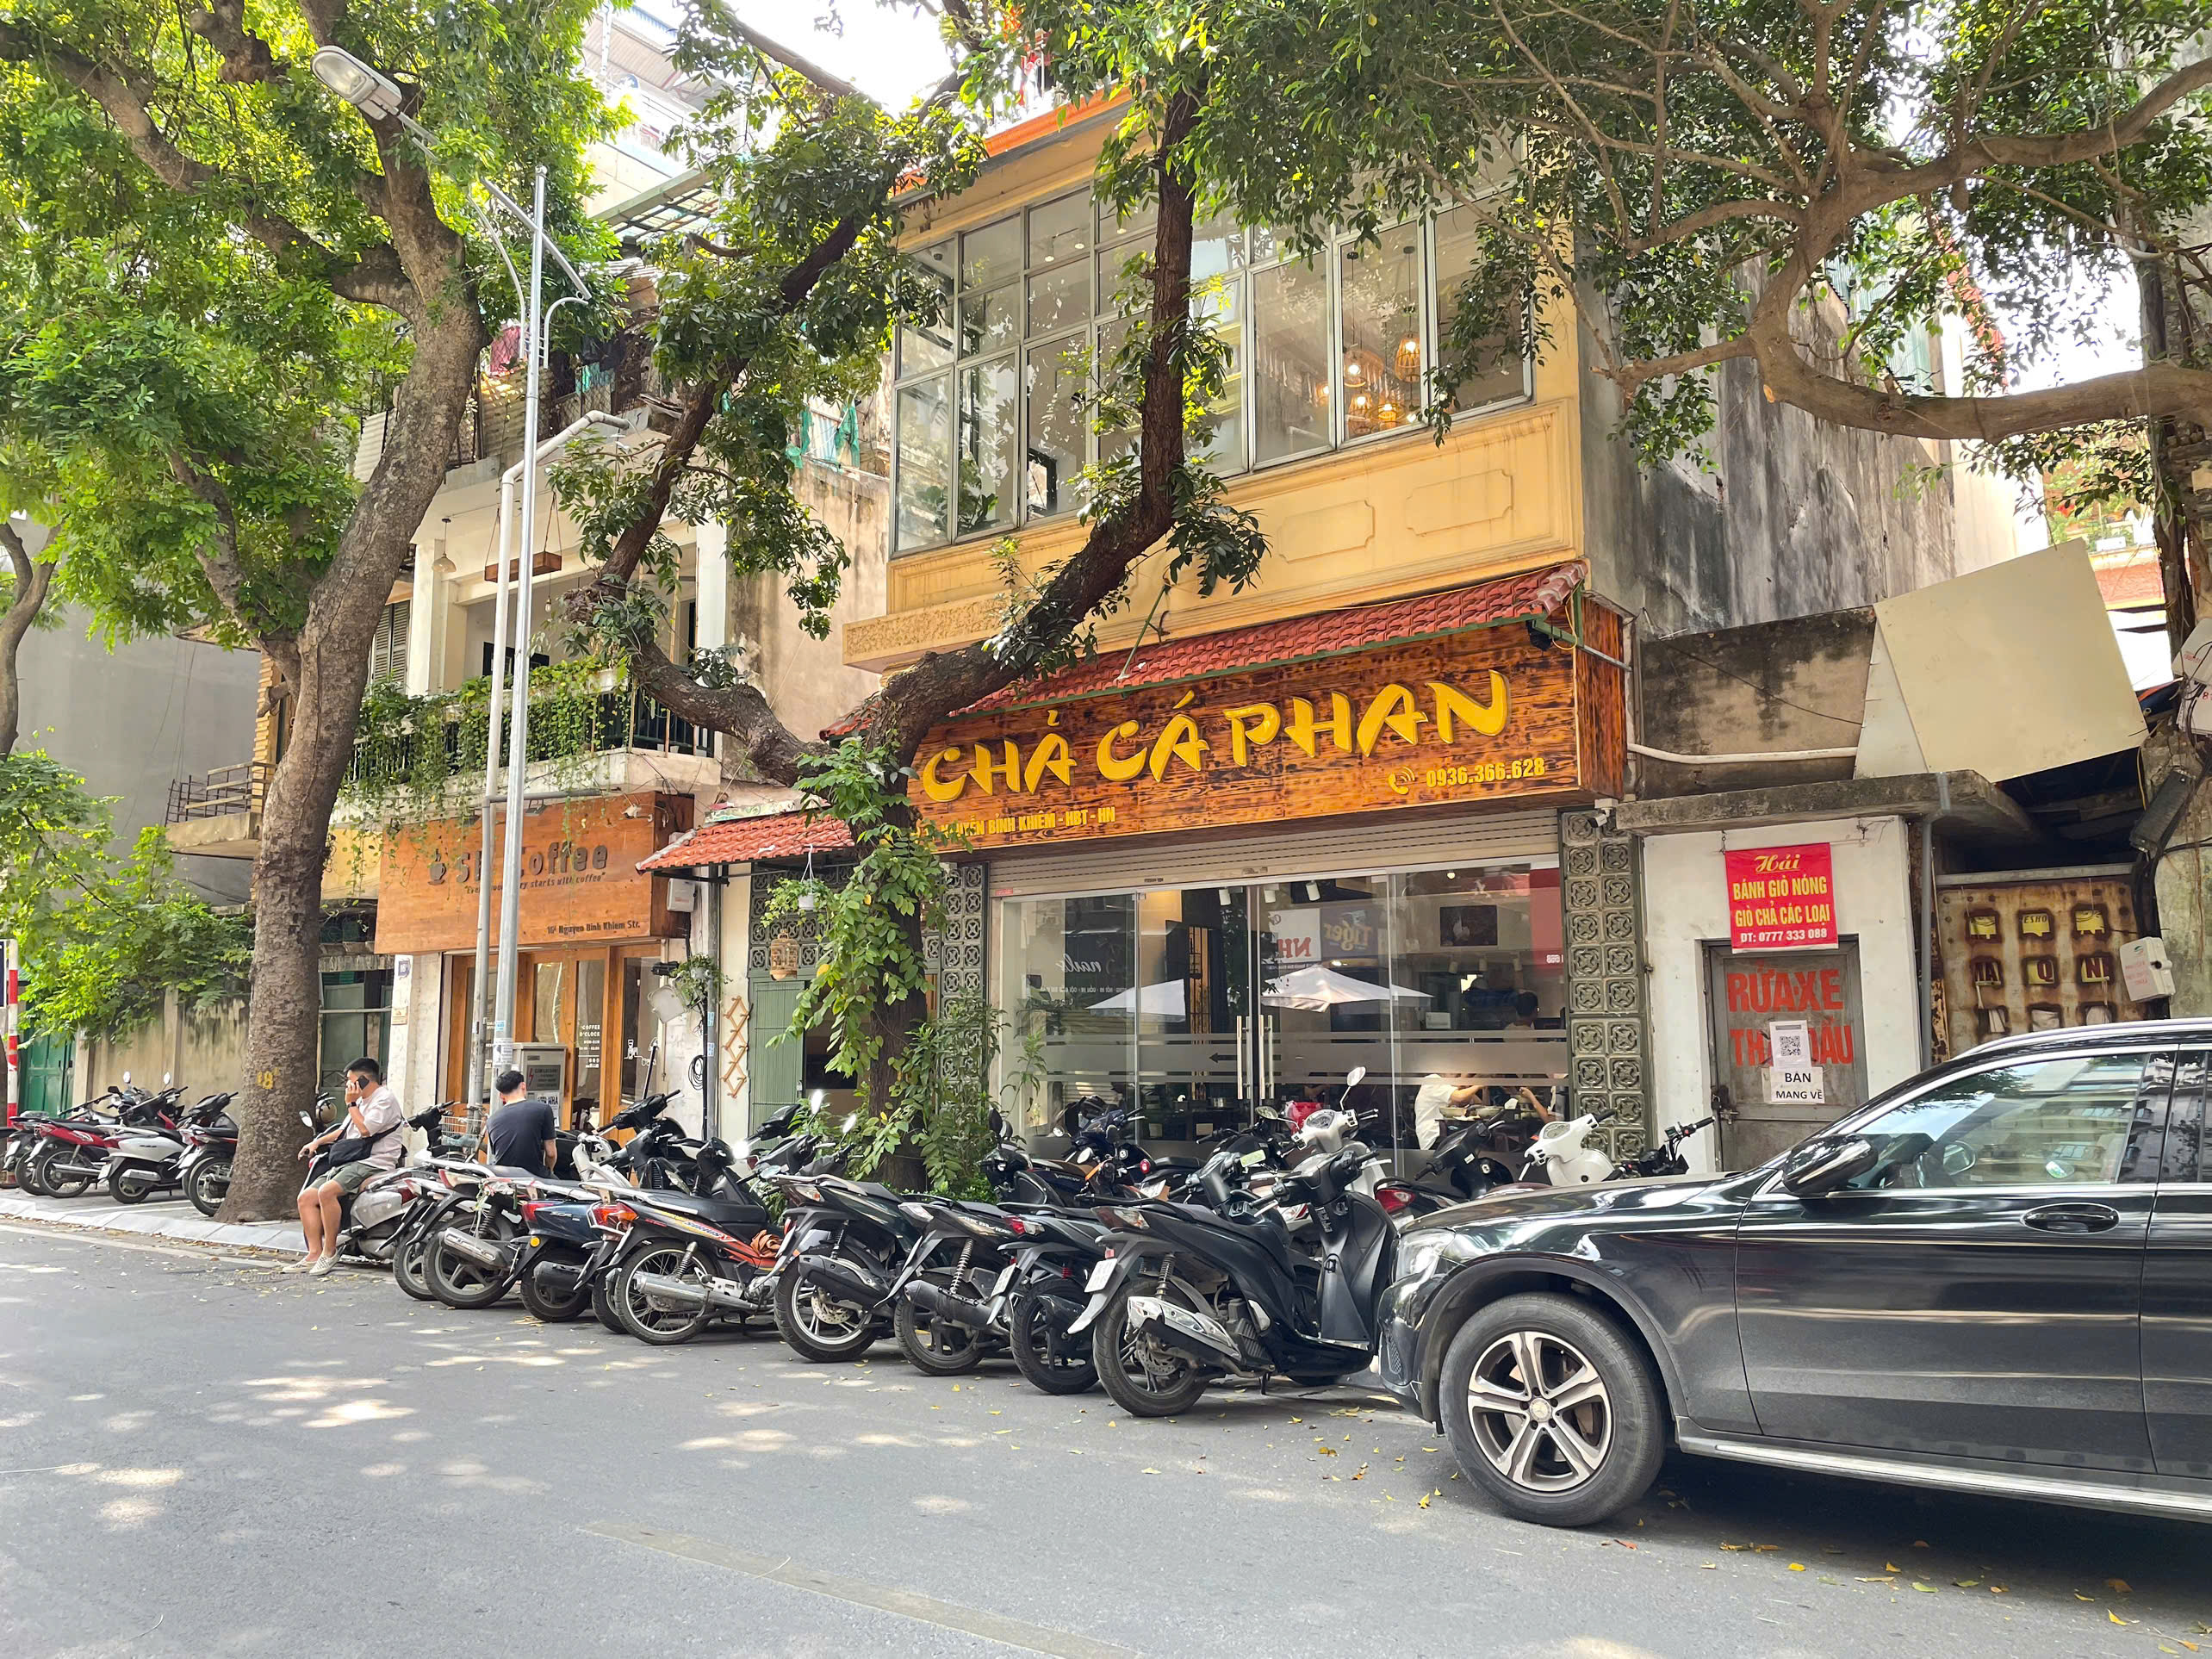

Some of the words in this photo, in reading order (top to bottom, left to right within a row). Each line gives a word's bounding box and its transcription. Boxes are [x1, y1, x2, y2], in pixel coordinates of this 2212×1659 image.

[923, 709, 1077, 802] CHẢ
[1097, 689, 1210, 783] CÁ
[1223, 669, 1510, 767] PHAN
[1426, 758, 1545, 788] 0936.366.628
[1066, 810, 1089, 827] HBT
[1098, 807, 1115, 823] HN
[1733, 878, 1765, 901] BÁNH
[1768, 875, 1789, 898] GIÒ
[1793, 873, 1827, 896] NÓNG
[1735, 905, 1754, 927] GIÒ
[1755, 900, 1778, 926] CHẢ
[1780, 903, 1803, 925] CÁC
[1805, 904, 1830, 926] LOẠI
[1759, 931, 1784, 942] 0777
[1786, 929, 1805, 941] 333
[1807, 928, 1827, 939] 088
[1730, 1028, 1773, 1068] TH
[1776, 1090, 1807, 1100] MANG
